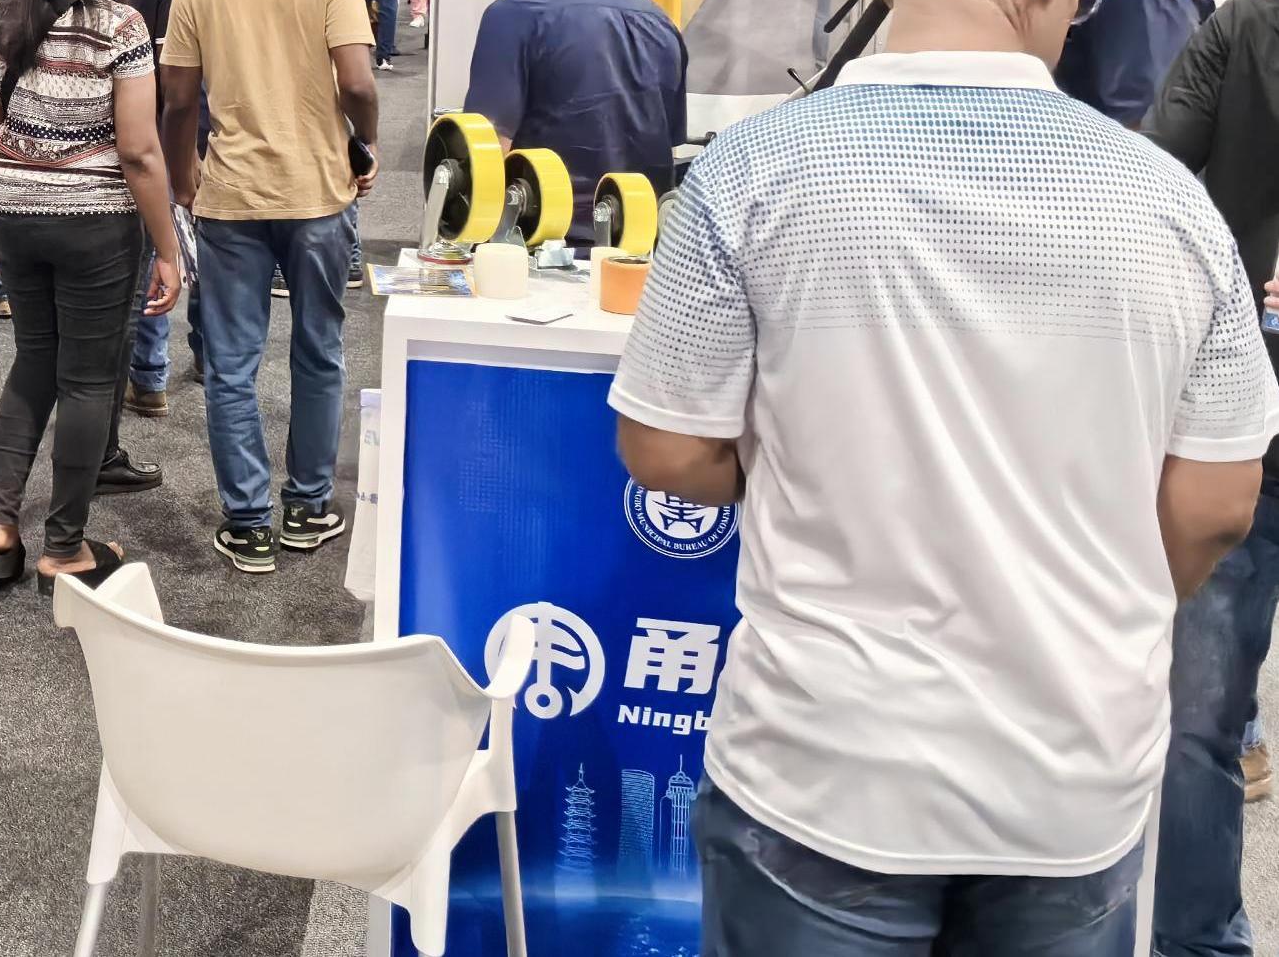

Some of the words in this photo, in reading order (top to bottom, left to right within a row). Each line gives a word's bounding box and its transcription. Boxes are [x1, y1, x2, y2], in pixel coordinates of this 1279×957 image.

[637, 512, 672, 548] MUNICIPAL
[673, 540, 708, 551] BUREAU
[707, 532, 719, 543] OF
